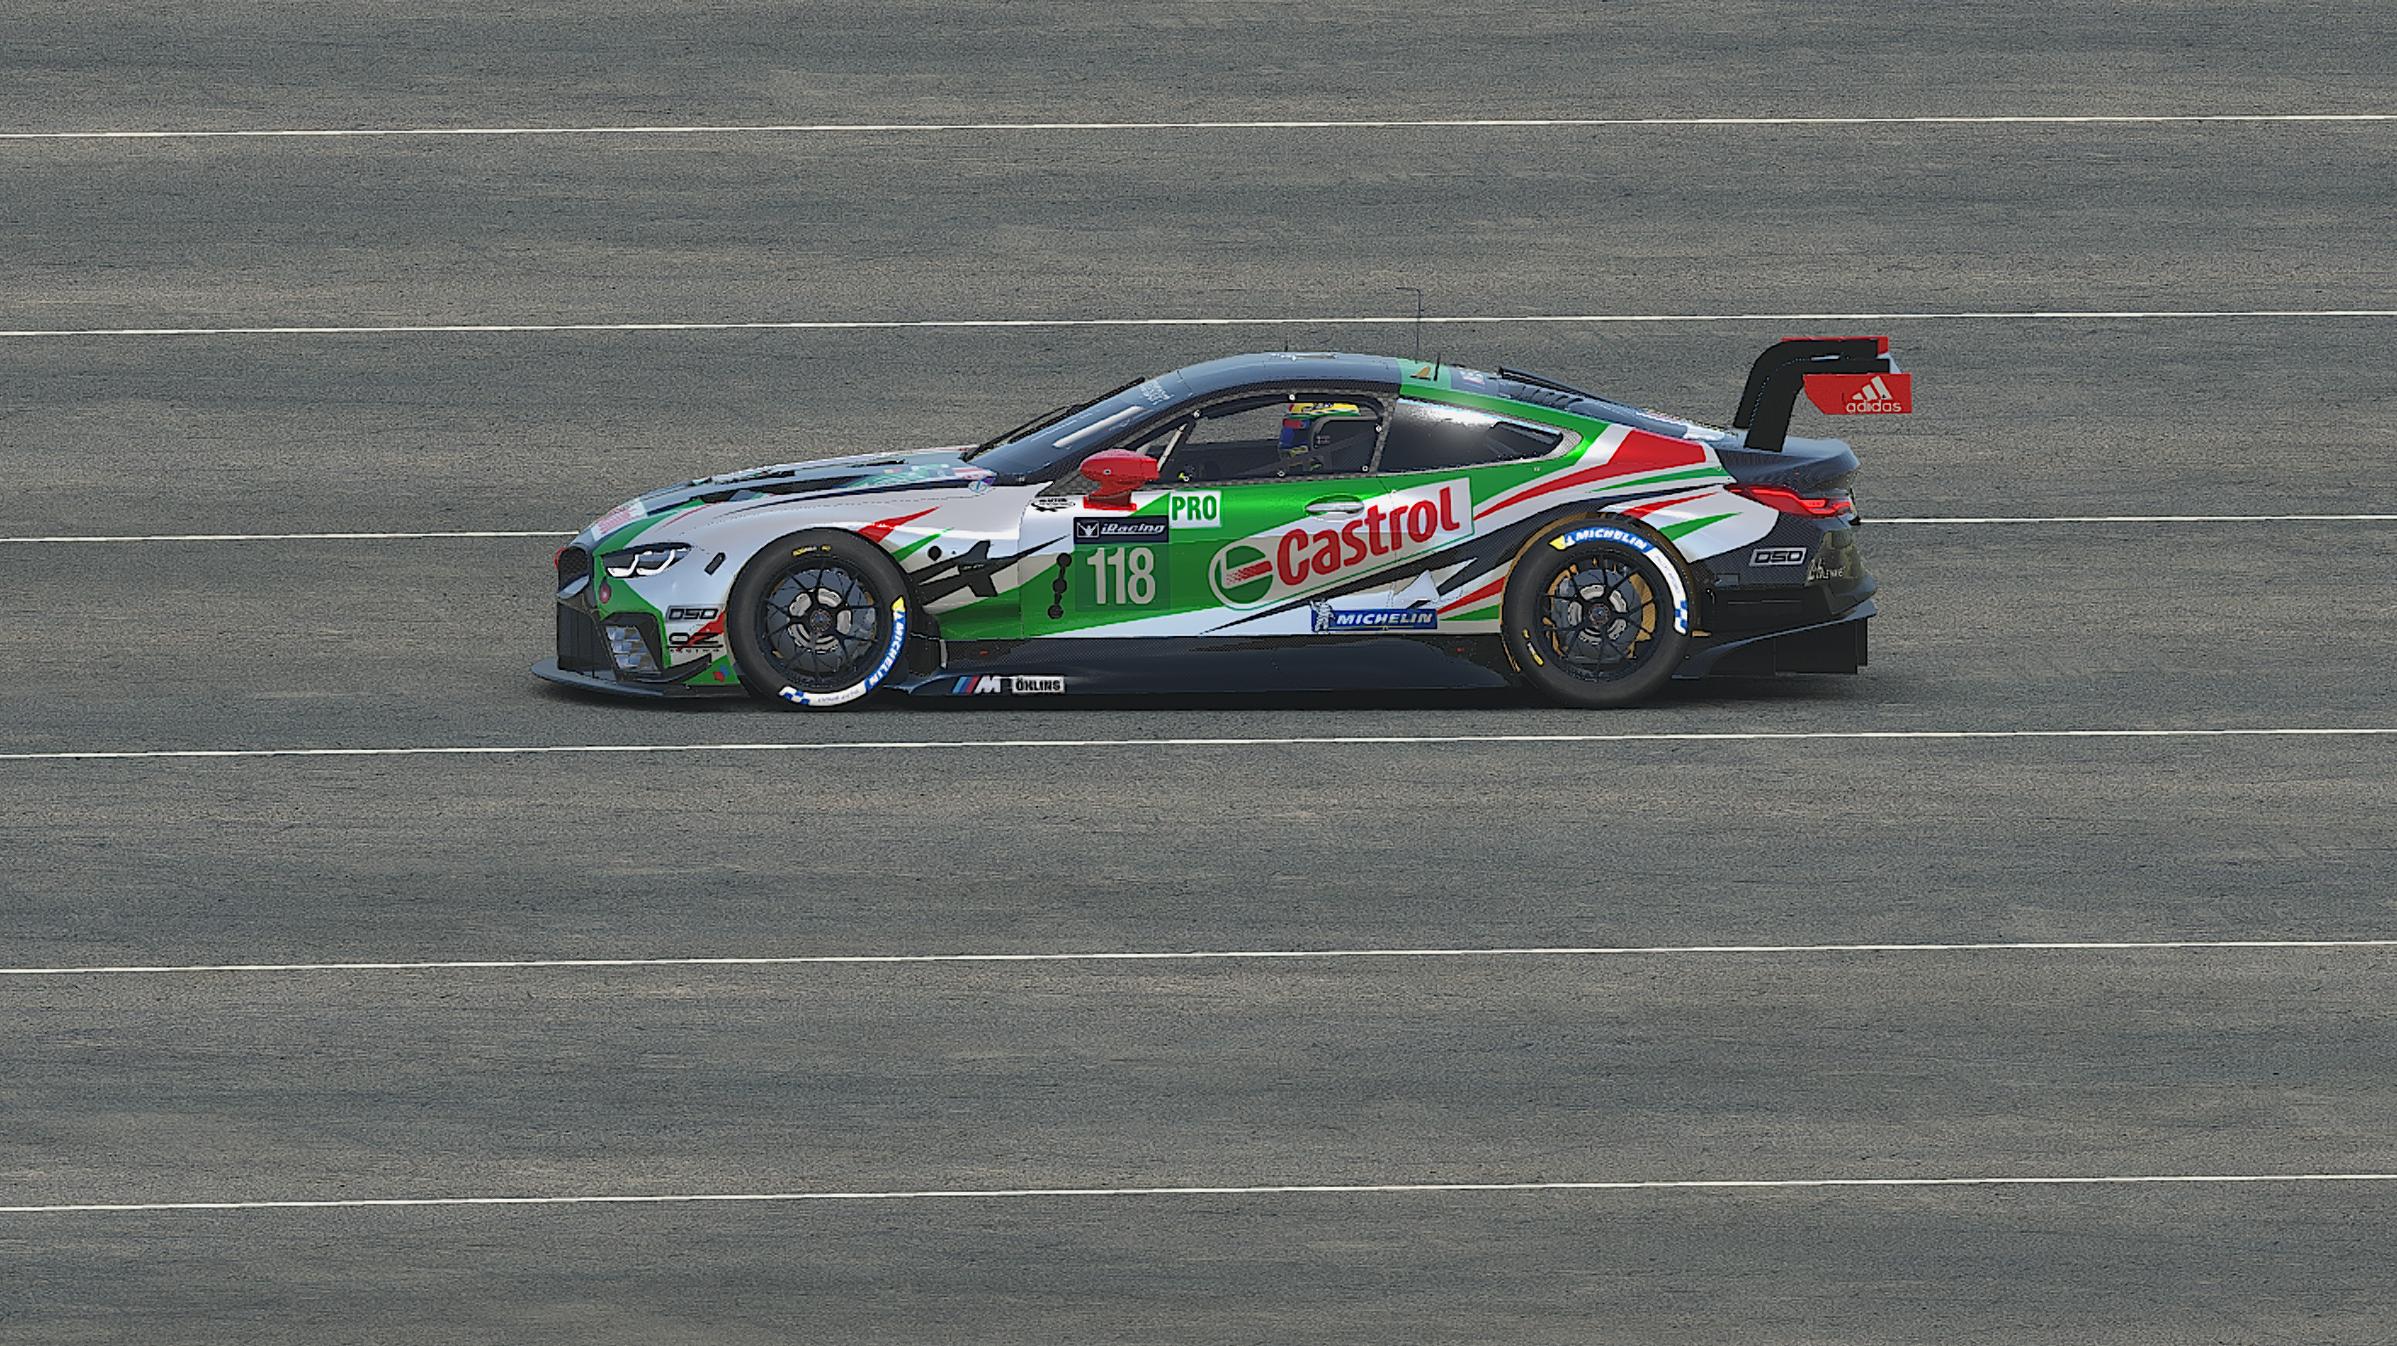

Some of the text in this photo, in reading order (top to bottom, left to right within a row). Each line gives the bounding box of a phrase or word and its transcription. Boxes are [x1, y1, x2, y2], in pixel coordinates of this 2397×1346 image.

[1845, 399, 1902, 413] adidas
[1171, 495, 1218, 521] PRO
[1100, 522, 1167, 534] iRacing
[1276, 486, 1460, 586] Castrol
[1574, 528, 1649, 550] MICHELIN
[1086, 546, 1157, 605] 118
[1336, 612, 1434, 626] MICHELIN
[868, 621, 905, 686] MICHELIN
